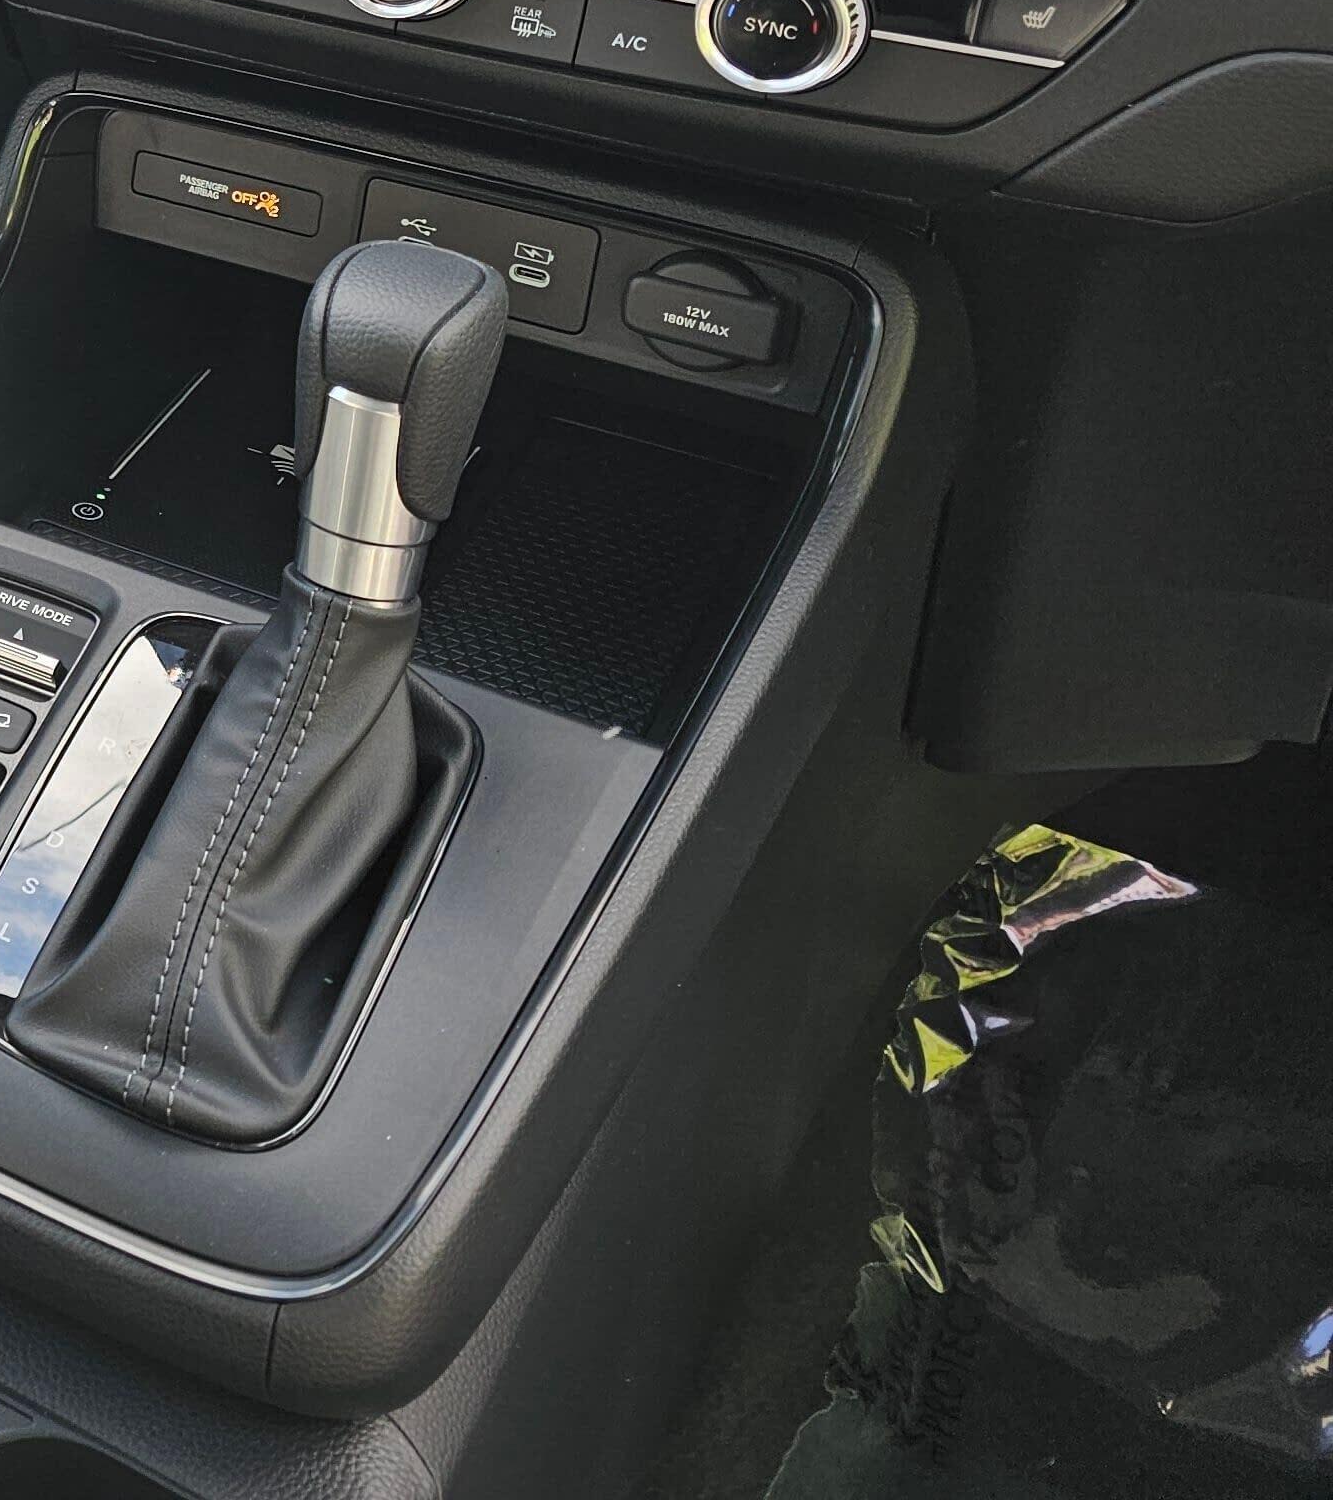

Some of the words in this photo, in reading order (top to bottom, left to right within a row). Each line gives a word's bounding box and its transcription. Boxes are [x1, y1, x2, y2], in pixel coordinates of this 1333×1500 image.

[513, 5, 543, 19] REAR
[743, 16, 799, 40] SYNC
[611, 32, 648, 51] A/C
[179, 174, 229, 194] PASSENGER
[188, 185, 220, 200] AIRBAG
[231, 190, 259, 206] OFF
[686, 305, 711, 320] 12V
[663, 312, 697, 329] 180W
[698, 321, 730, 338] MAX
[31, 604, 73, 627] MODE
[98, 737, 116, 756] R
[46, 832, 64, 848] D
[21, 877, 40, 894] S
